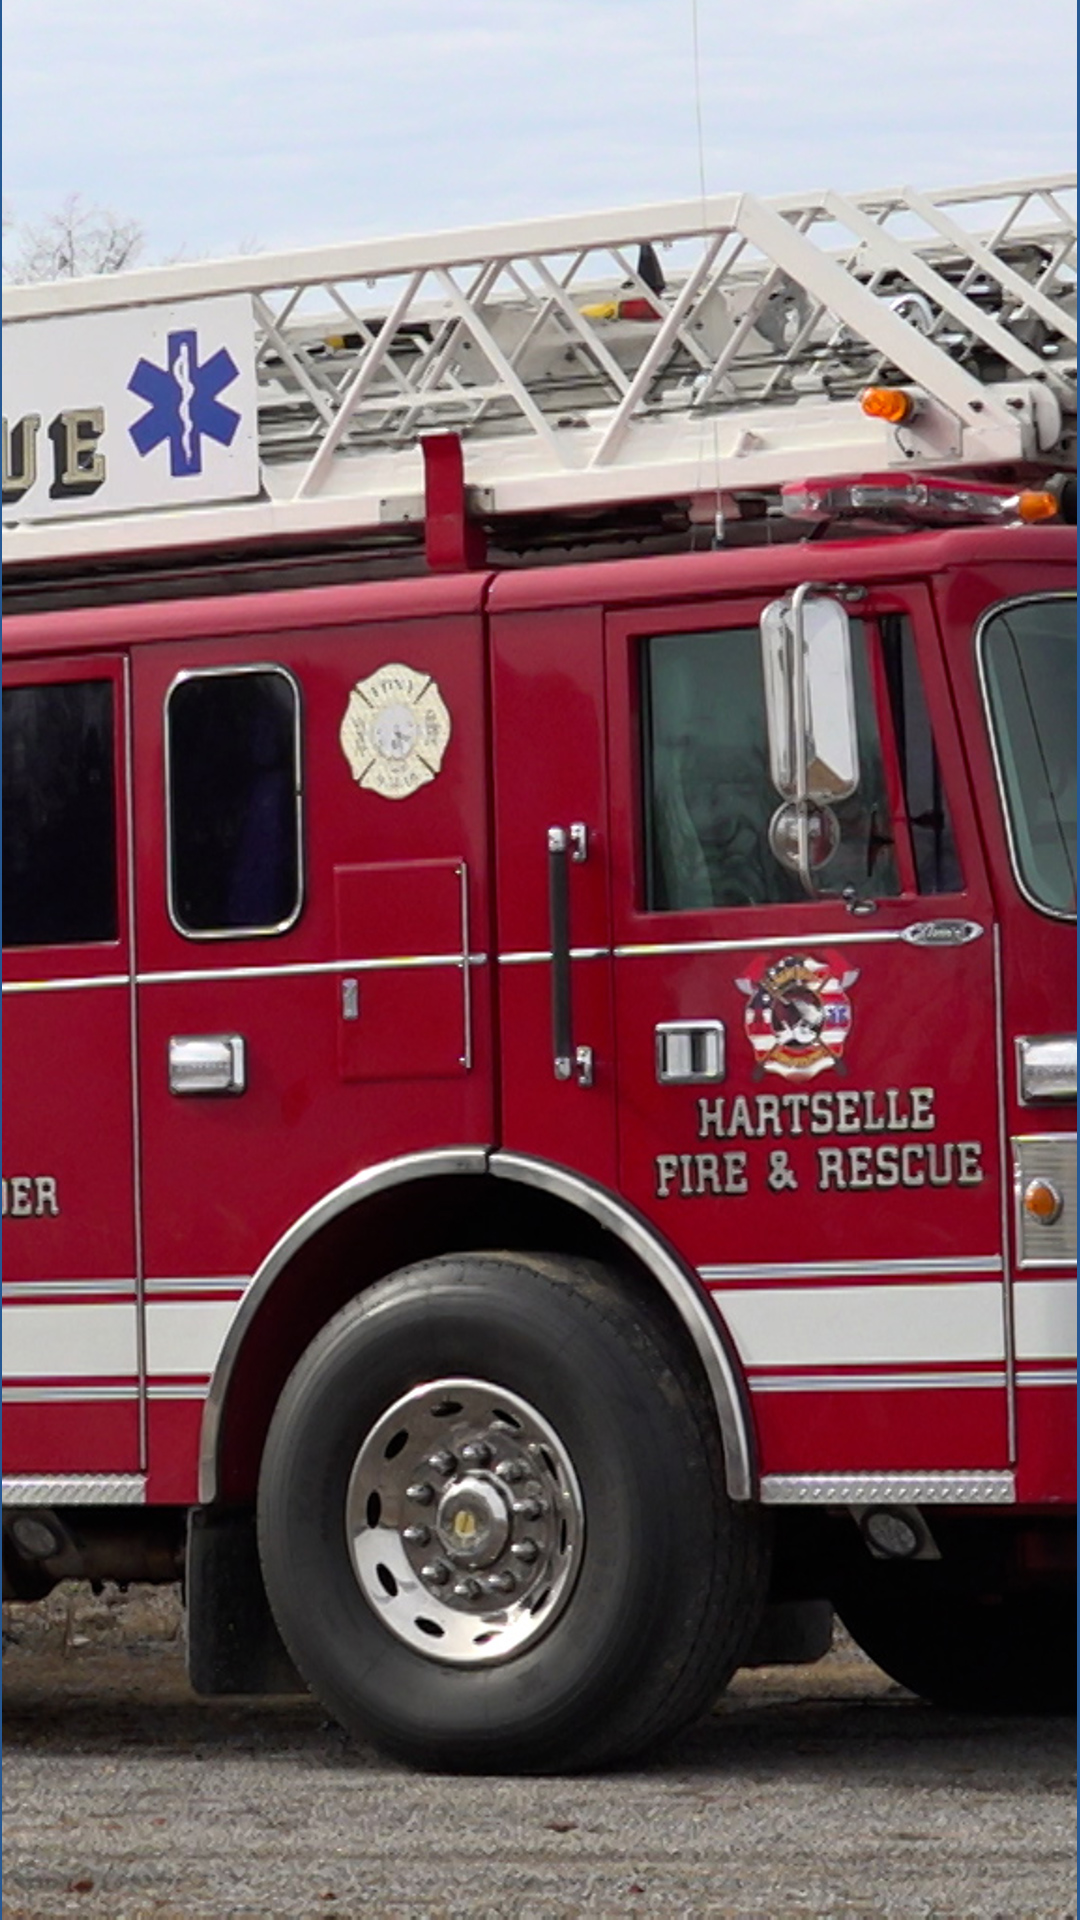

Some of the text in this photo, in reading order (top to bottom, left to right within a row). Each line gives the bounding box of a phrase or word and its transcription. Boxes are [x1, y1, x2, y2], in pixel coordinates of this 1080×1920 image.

[697, 1087, 936, 1137] HARTSELLE
[656, 1141, 984, 1197] FIRE & RESCUE
